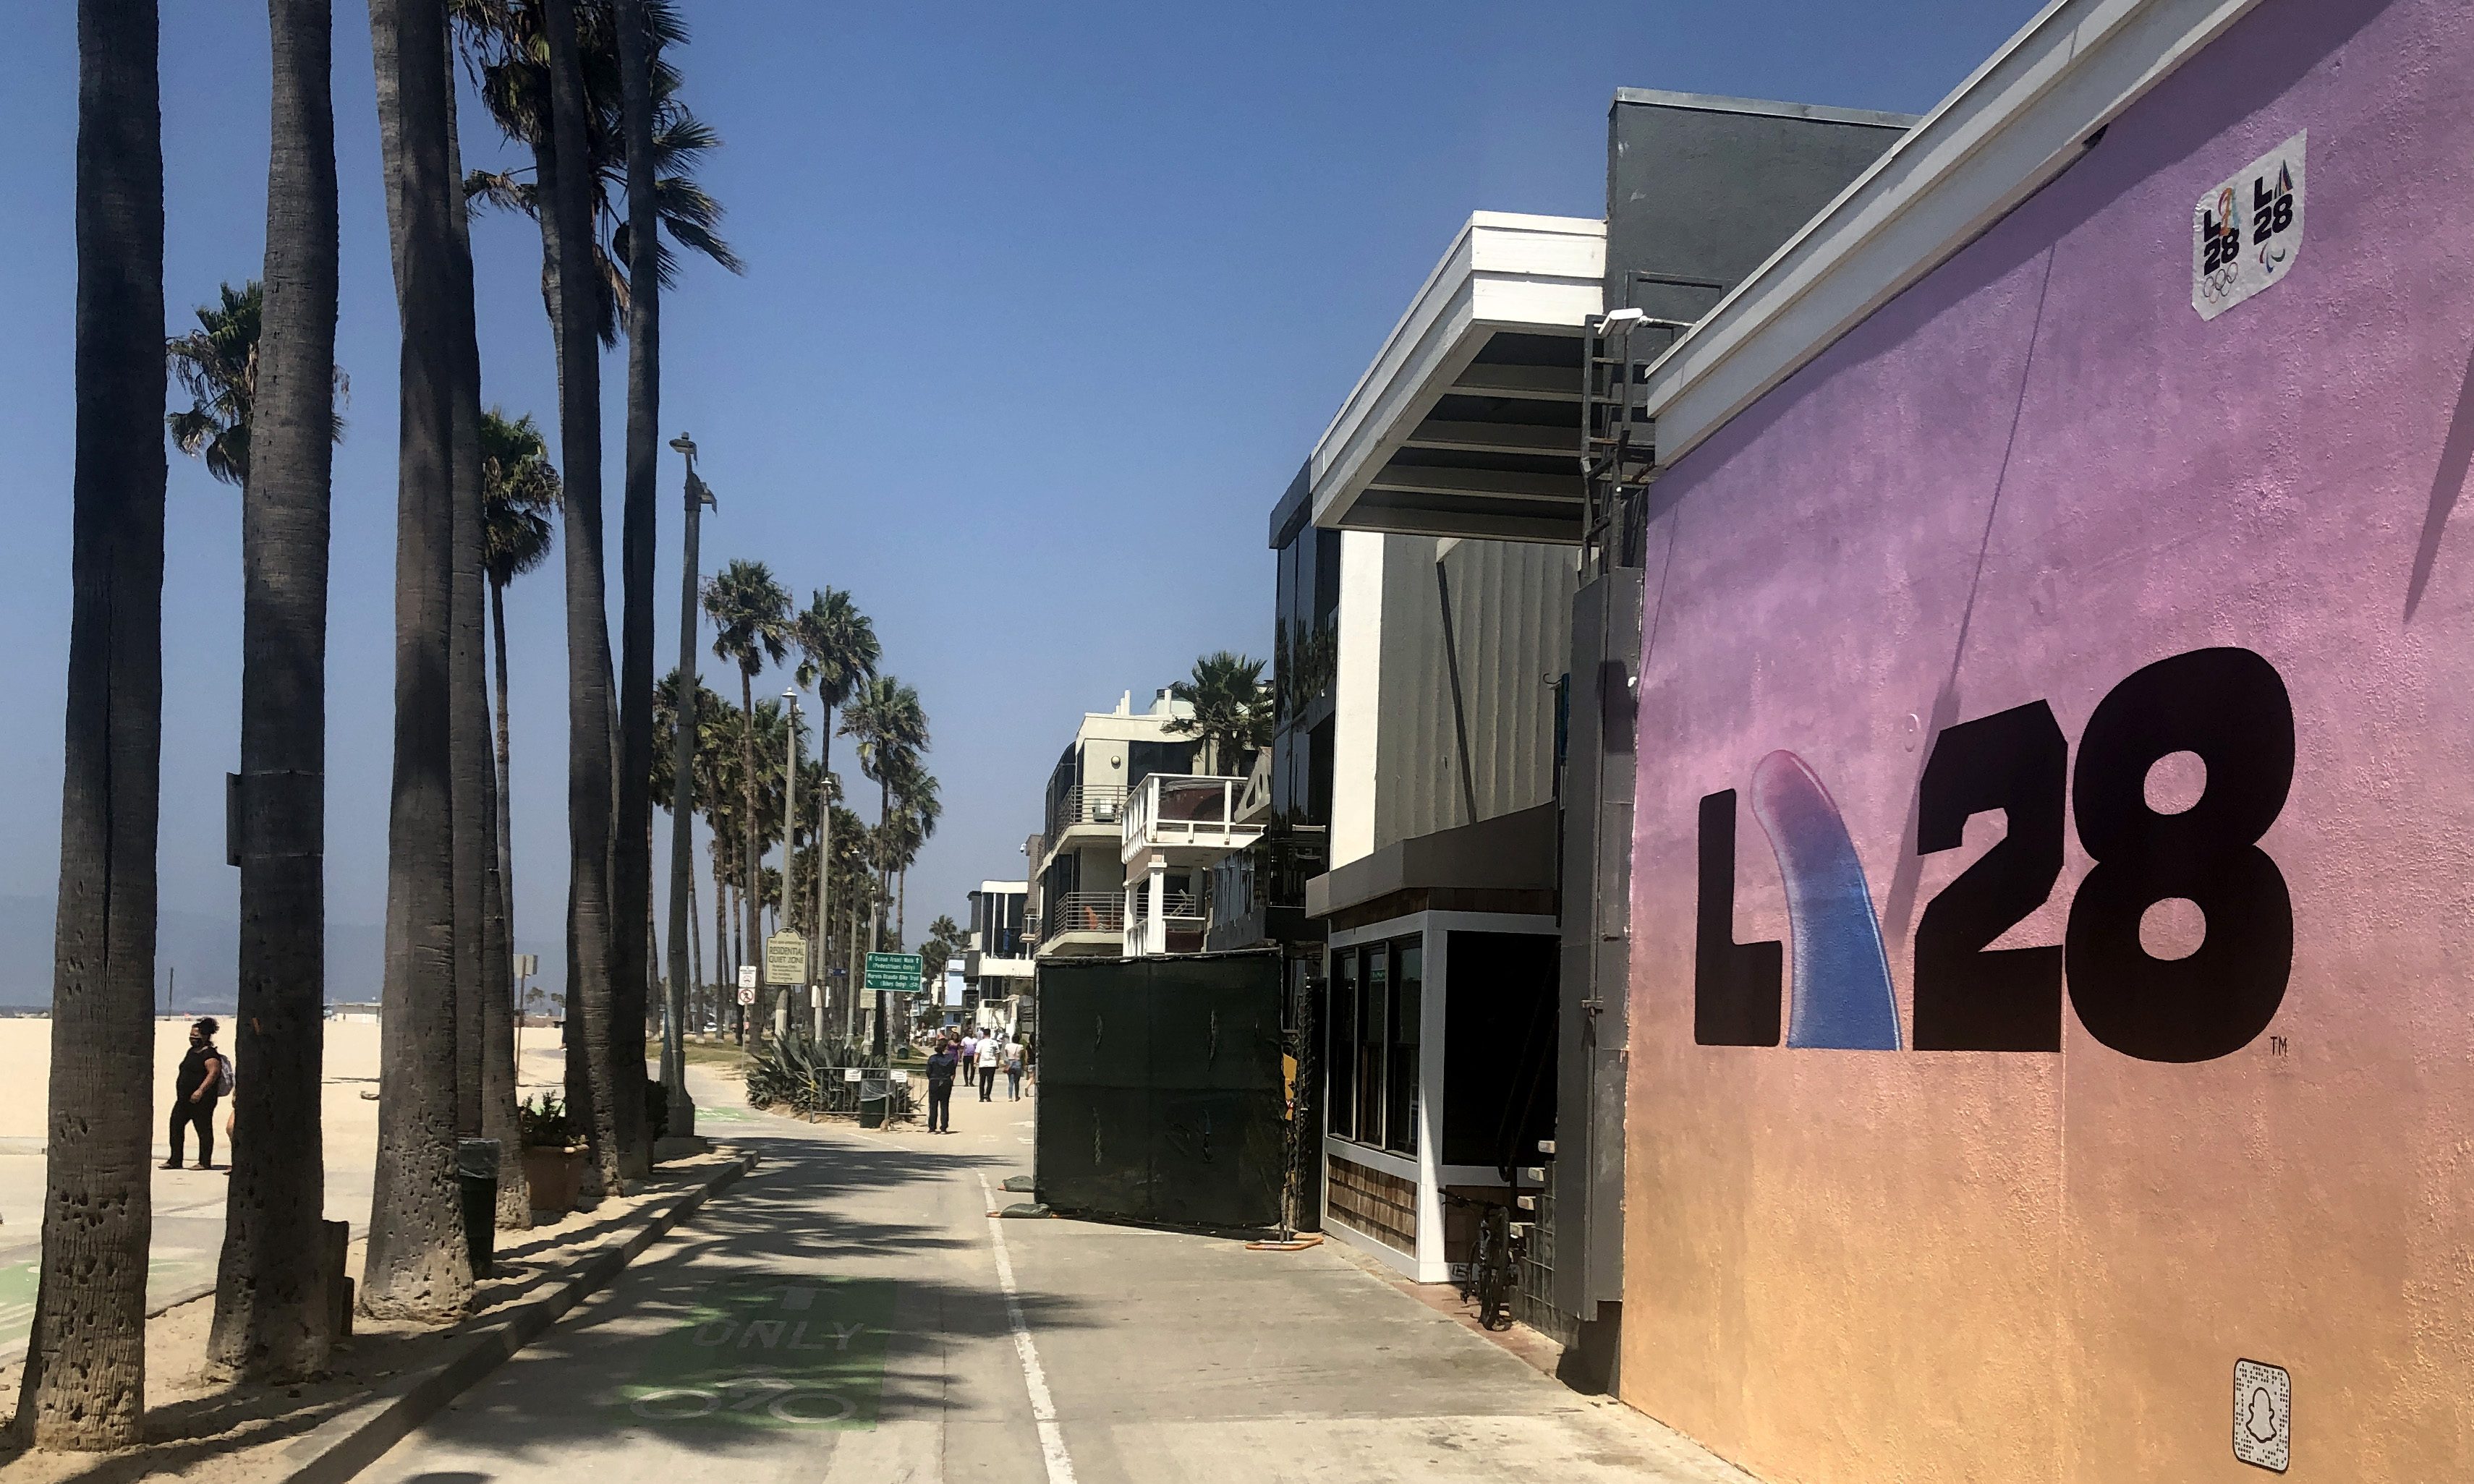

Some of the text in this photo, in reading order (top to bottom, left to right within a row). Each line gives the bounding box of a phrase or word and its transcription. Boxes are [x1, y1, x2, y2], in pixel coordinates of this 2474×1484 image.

[2253, 193, 2293, 246] 28
[2203, 228, 2240, 277] 28
[769, 947, 804, 955] RESIDENTIAL
[2269, 1036, 2287, 1057] TM
[692, 1319, 864, 1351] ONLY
